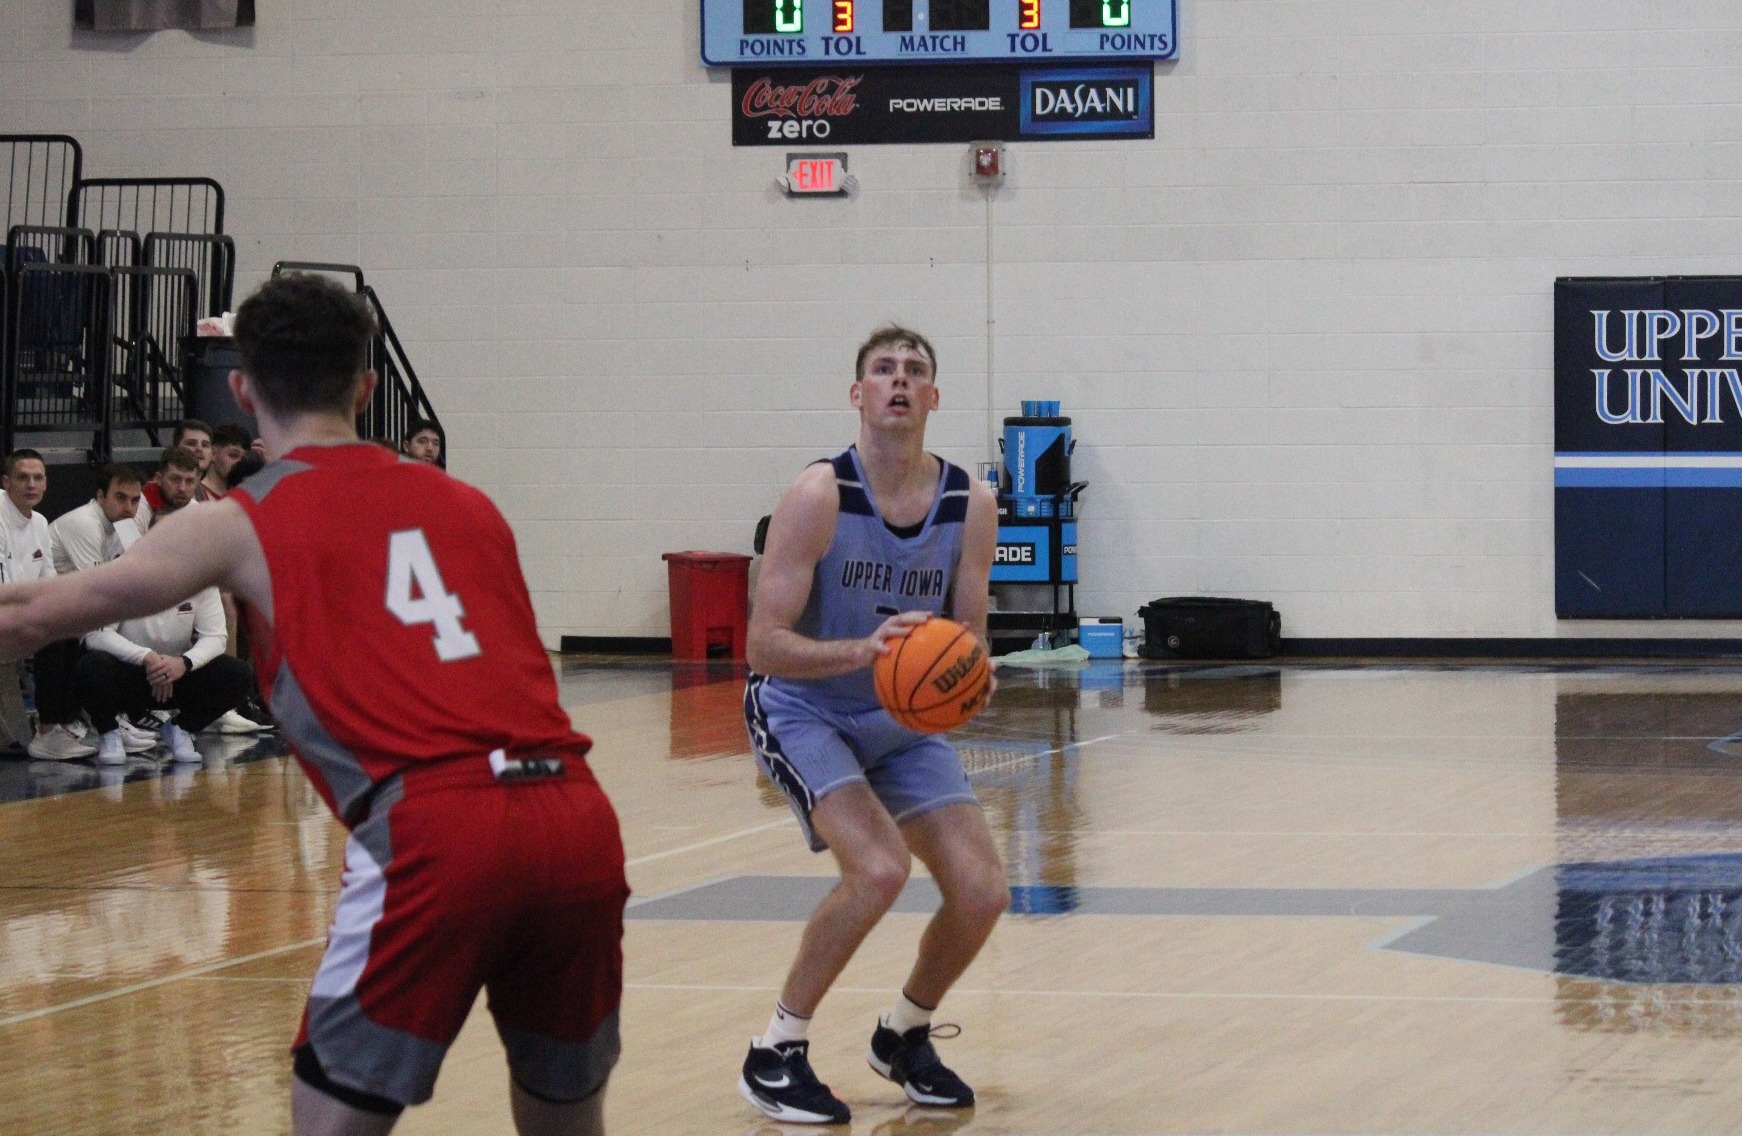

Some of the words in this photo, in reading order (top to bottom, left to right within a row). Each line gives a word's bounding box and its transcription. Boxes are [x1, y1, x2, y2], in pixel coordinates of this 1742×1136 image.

[834, 1, 852, 31] 3
[1021, 0, 1039, 28] 3
[739, 38, 806, 56] POINTS
[820, 35, 867, 56] TOL
[899, 34, 966, 52] MATCH
[1006, 32, 1053, 53] TOL
[1099, 33, 1168, 51] POINTS
[741, 74, 864, 118] Coca-Cola
[889, 97, 1001, 113] POWERADE
[1035, 83, 1135, 117] DASANI
[767, 119, 831, 138] zero
[797, 160, 834, 190] EXIT
[1017, 431, 1026, 493] POWERADE
[993, 546, 1032, 562] ADE
[841, 560, 892, 593] UPPER
[899, 569, 943, 597] IOWA
[385, 527, 482, 663] 4
